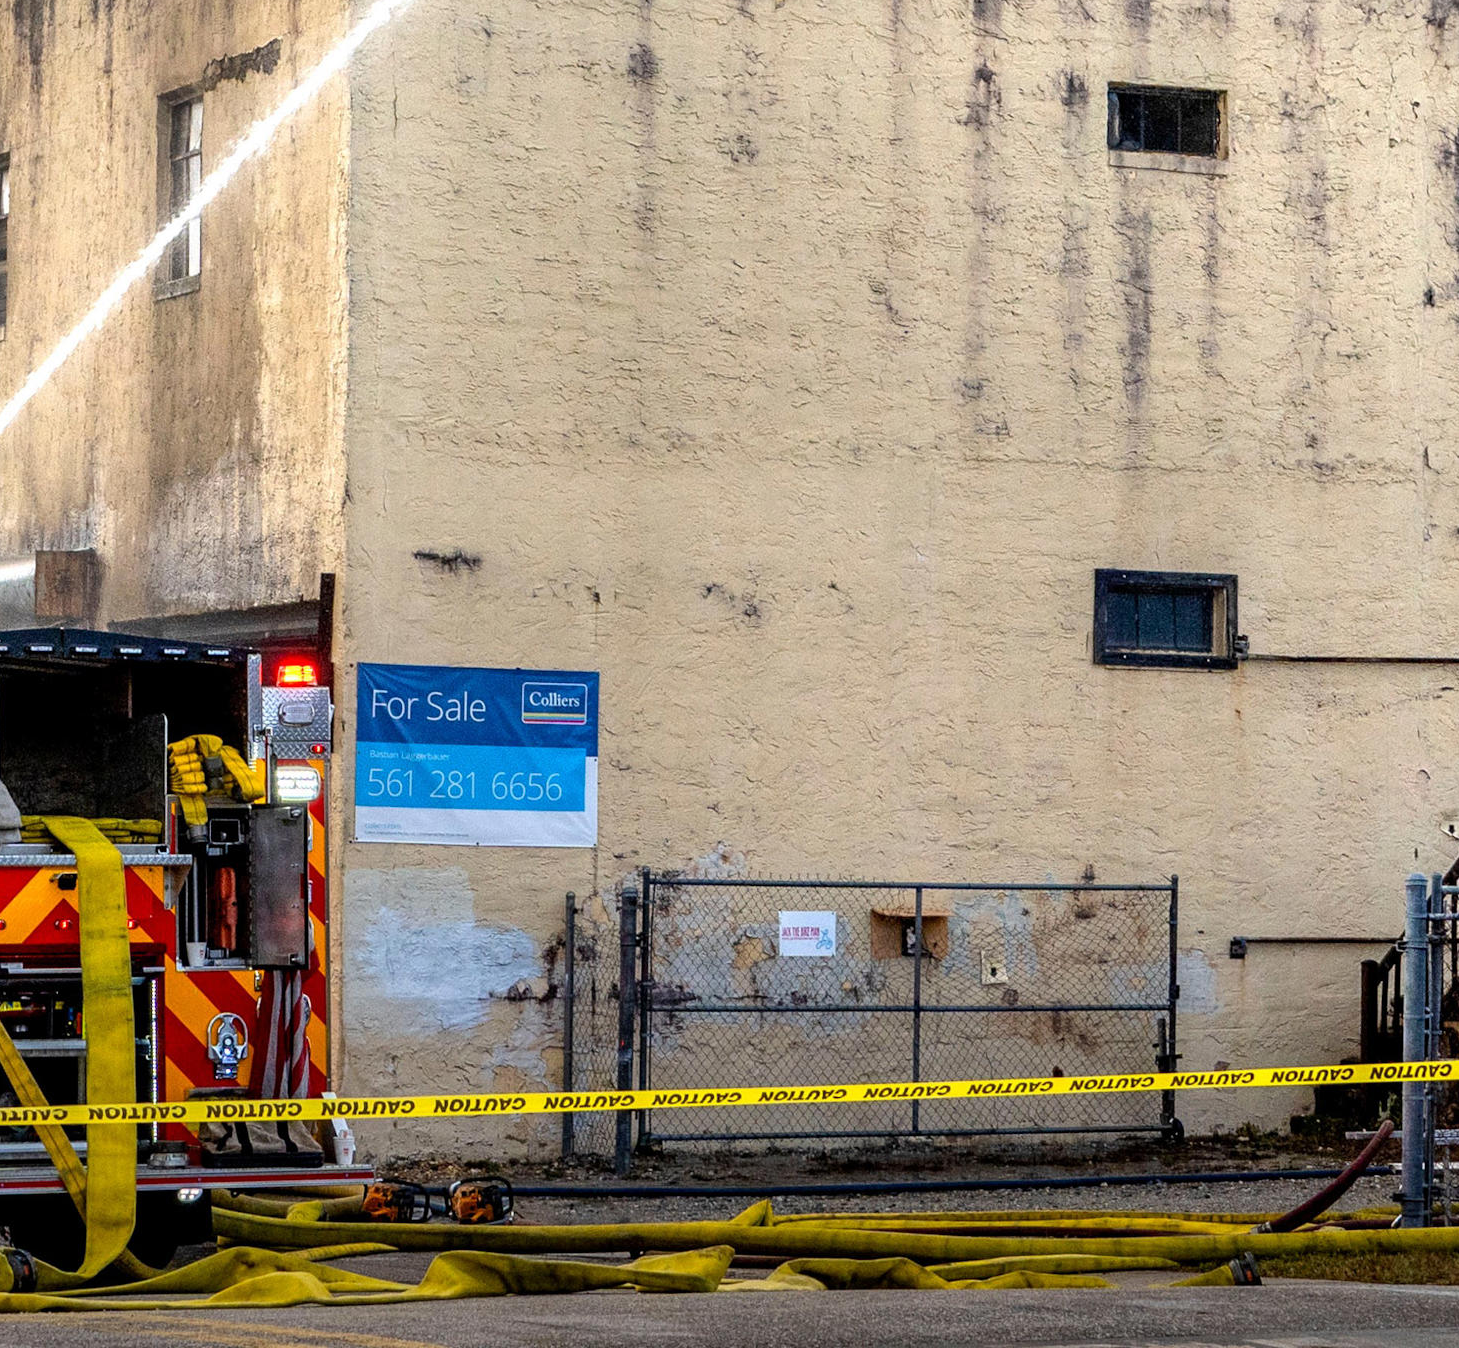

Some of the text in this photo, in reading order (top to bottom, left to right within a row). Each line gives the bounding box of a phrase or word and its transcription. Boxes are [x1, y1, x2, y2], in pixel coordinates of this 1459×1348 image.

[371, 689, 487, 723] For Sale
[529, 690, 581, 709] Colliers
[367, 768, 563, 802] 561 281 6656
[1170, 1071, 1255, 1087] CAUTION
[1270, 1067, 1355, 1083] CAUTION
[1369, 1063, 1453, 1080] CAUTION
[863, 1085, 951, 1098] CAUTION
[966, 1080, 1054, 1095] CAUTION
[1069, 1076, 1155, 1092] CAUTION
[543, 1094, 636, 1109] CAUTION
[651, 1091, 742, 1106] CAUTION
[758, 1088, 848, 1102] CAUTION
[88, 1105, 187, 1120] CAUTION
[206, 1102, 304, 1118] CAUTION
[321, 1100, 416, 1116] CAUTION
[433, 1097, 527, 1113] CAUTION
